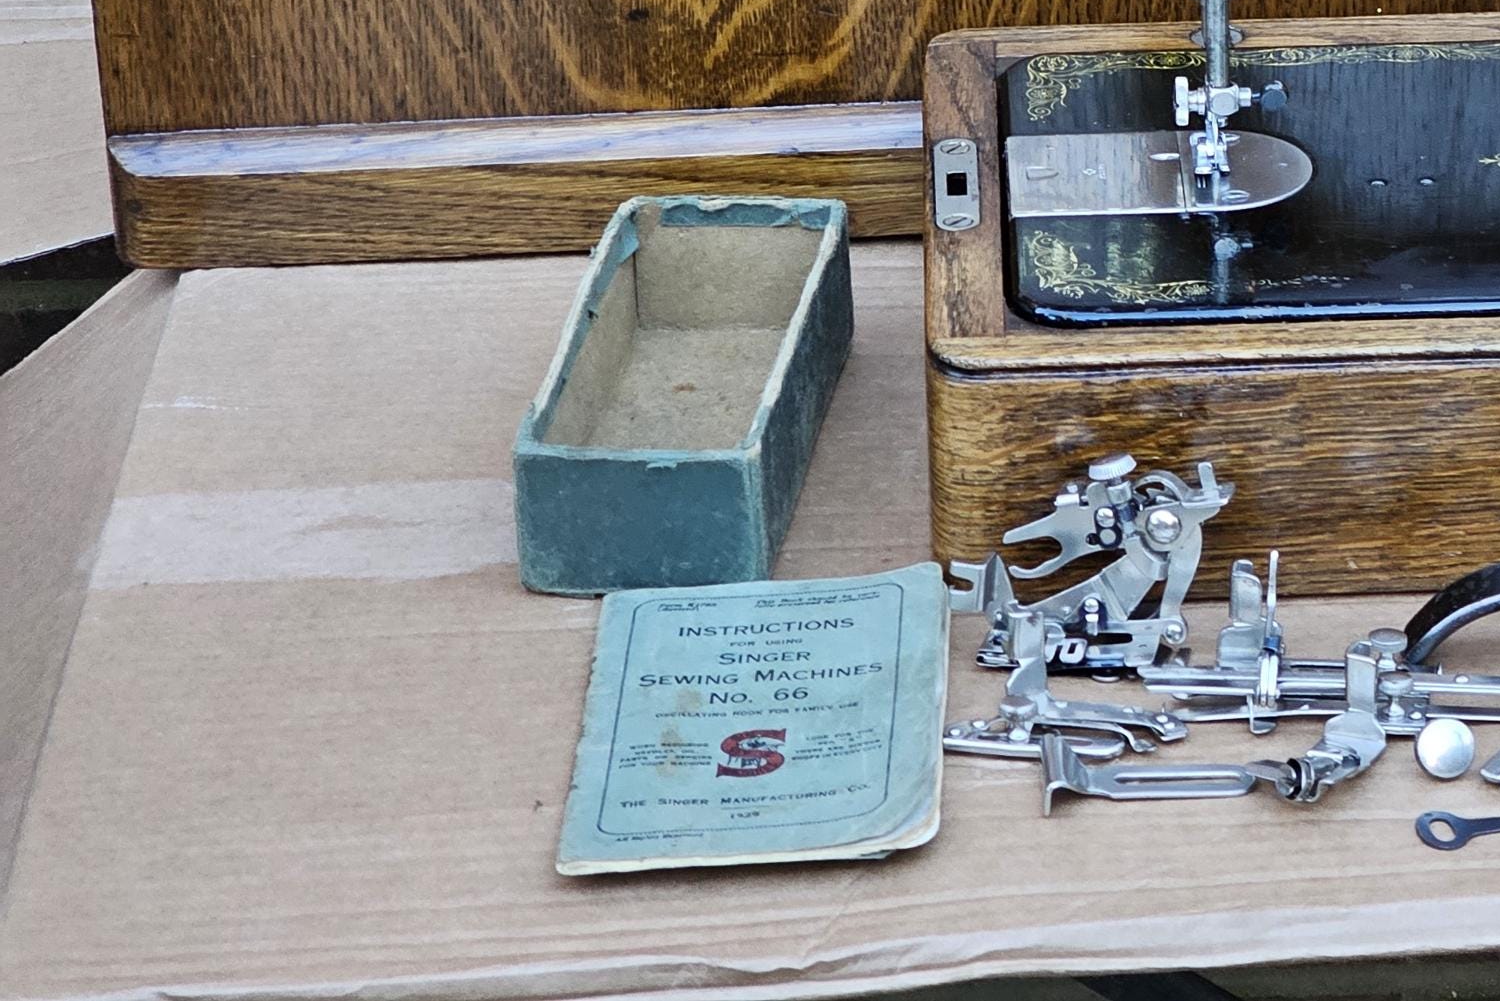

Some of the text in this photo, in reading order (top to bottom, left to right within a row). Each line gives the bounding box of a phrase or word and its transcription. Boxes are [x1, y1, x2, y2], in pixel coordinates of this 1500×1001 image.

[678, 617, 855, 637] INSTRUCTIONS
[718, 651, 811, 665] SINGER
[639, 662, 883, 687] SEWING MACHINES
[773, 686, 809, 701] 66
[656, 797, 709, 806] SINGER
[720, 789, 837, 805] MANUFACTURING
